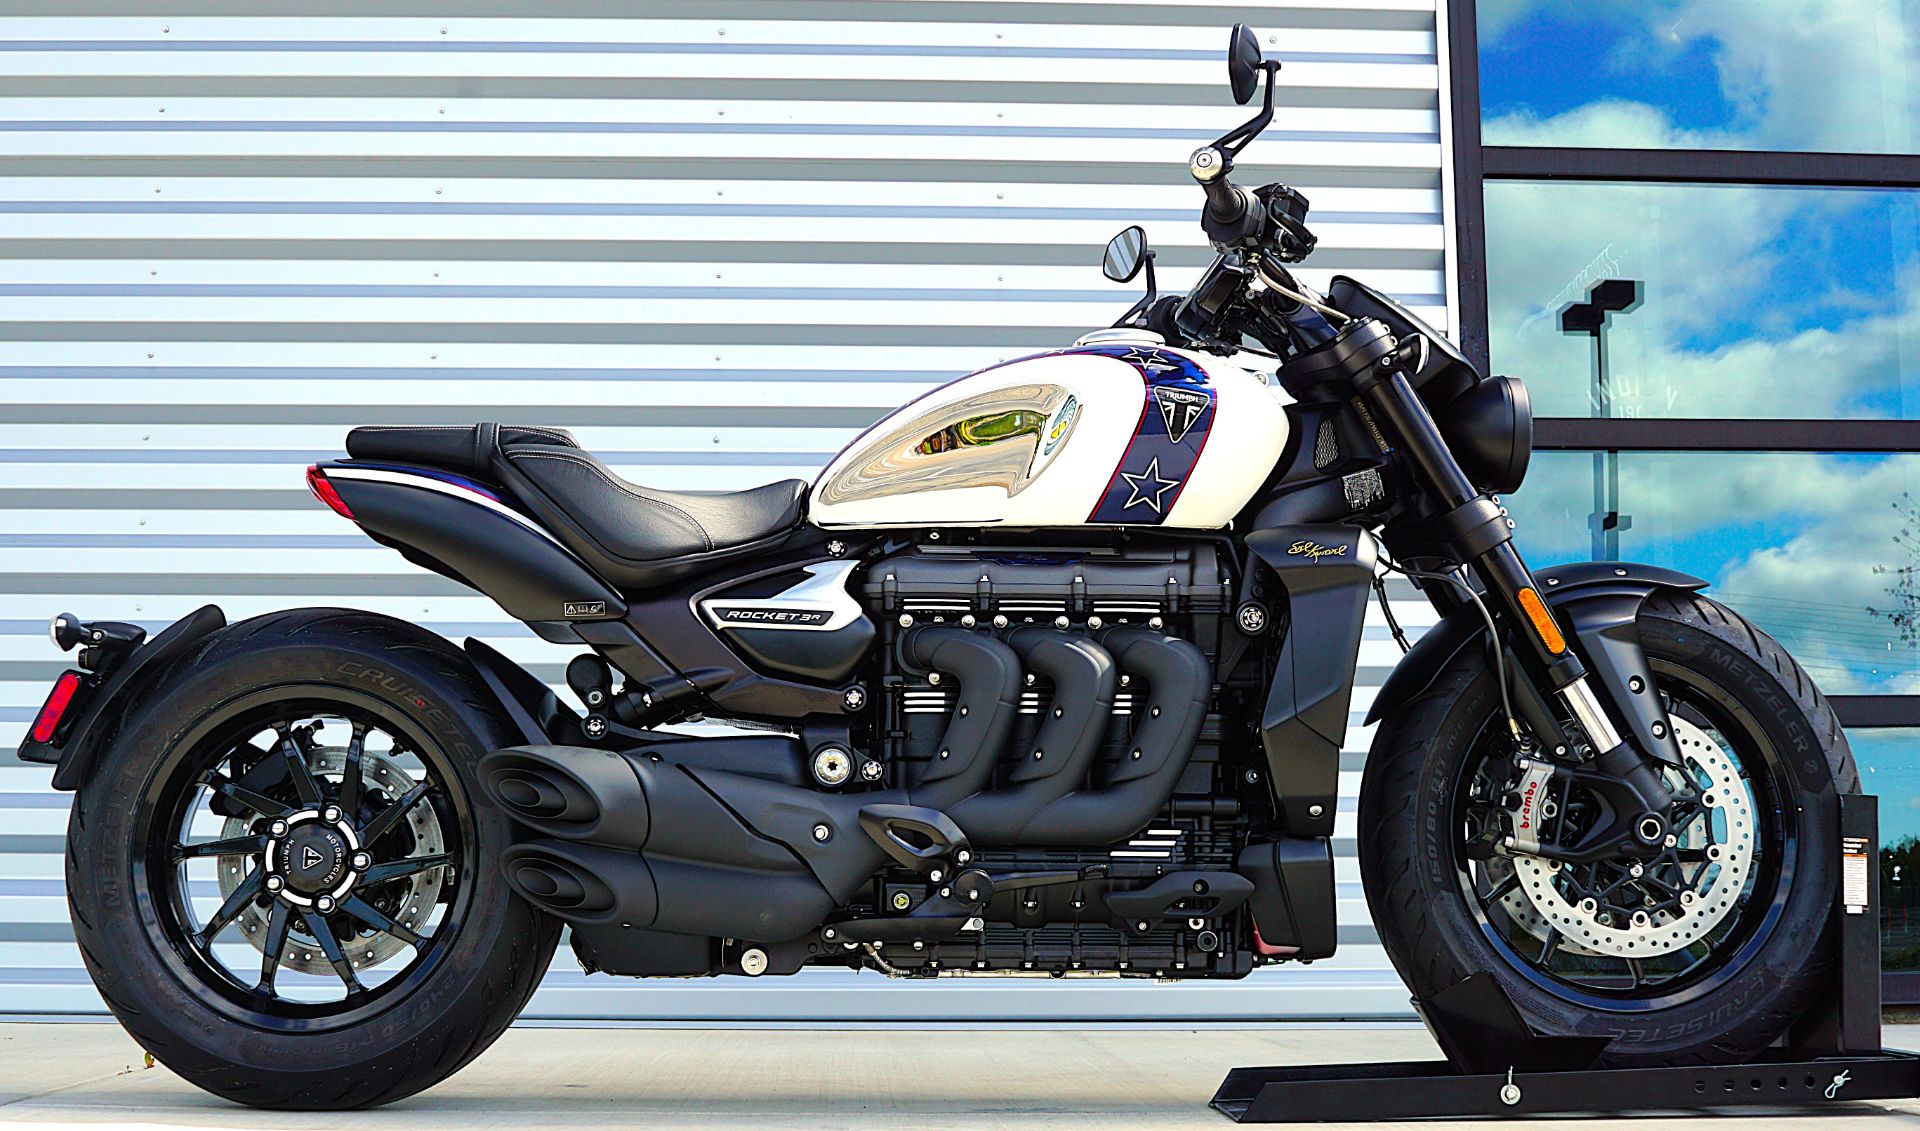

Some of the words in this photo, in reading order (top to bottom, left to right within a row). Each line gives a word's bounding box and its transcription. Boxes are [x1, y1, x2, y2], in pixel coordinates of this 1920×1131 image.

[1165, 391, 1199, 403] TRIUMPH
[1709, 648, 1809, 753] METZELER
[1520, 781, 1538, 830] brembo
[283, 839, 295, 875] TRIUMPH
[323, 833, 342, 884] MOTORCYCLES
